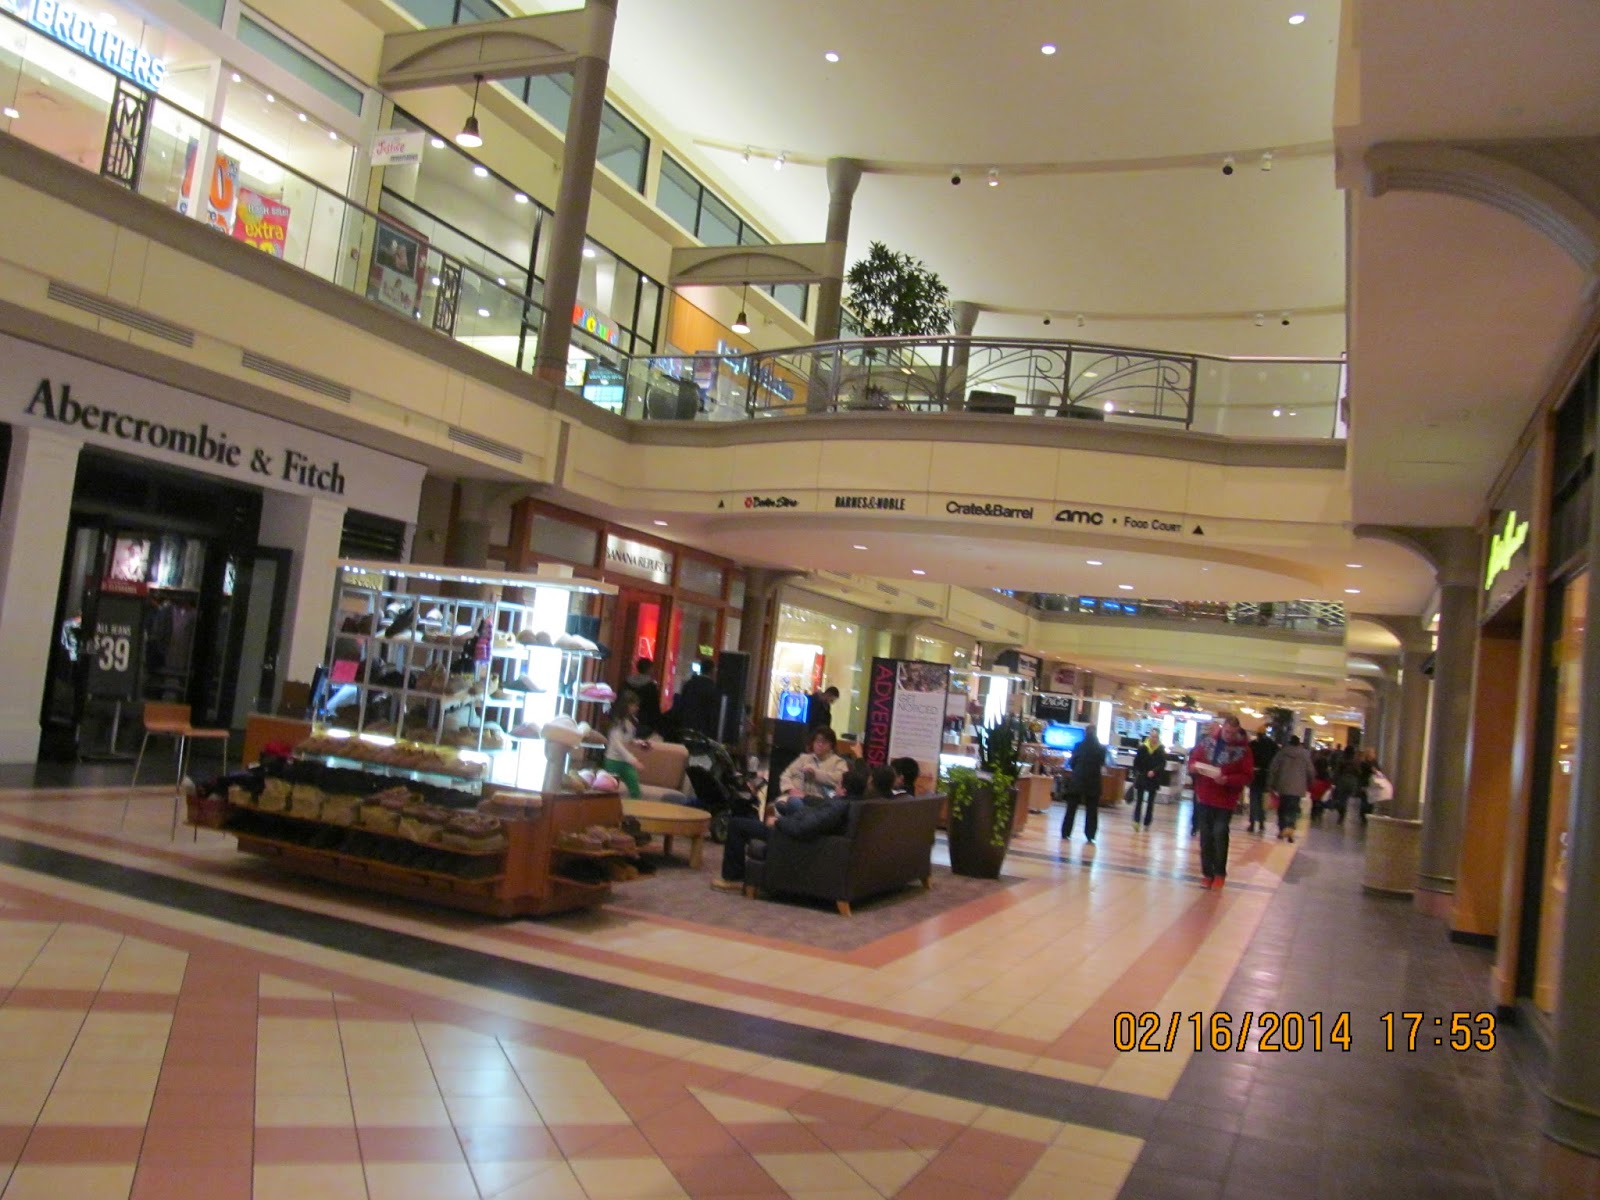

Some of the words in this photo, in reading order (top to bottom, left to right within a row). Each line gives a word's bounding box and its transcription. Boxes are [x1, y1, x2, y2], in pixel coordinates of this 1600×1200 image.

[29, 0, 166, 91] BROTHERS
[245, 221, 284, 241] extra
[24, 378, 241, 468] Abercrombie
[250, 448, 273, 475] &
[282, 449, 346, 496] Fitch
[946, 501, 1033, 520] Crate&Barrel
[1055, 509, 1104, 526] amc
